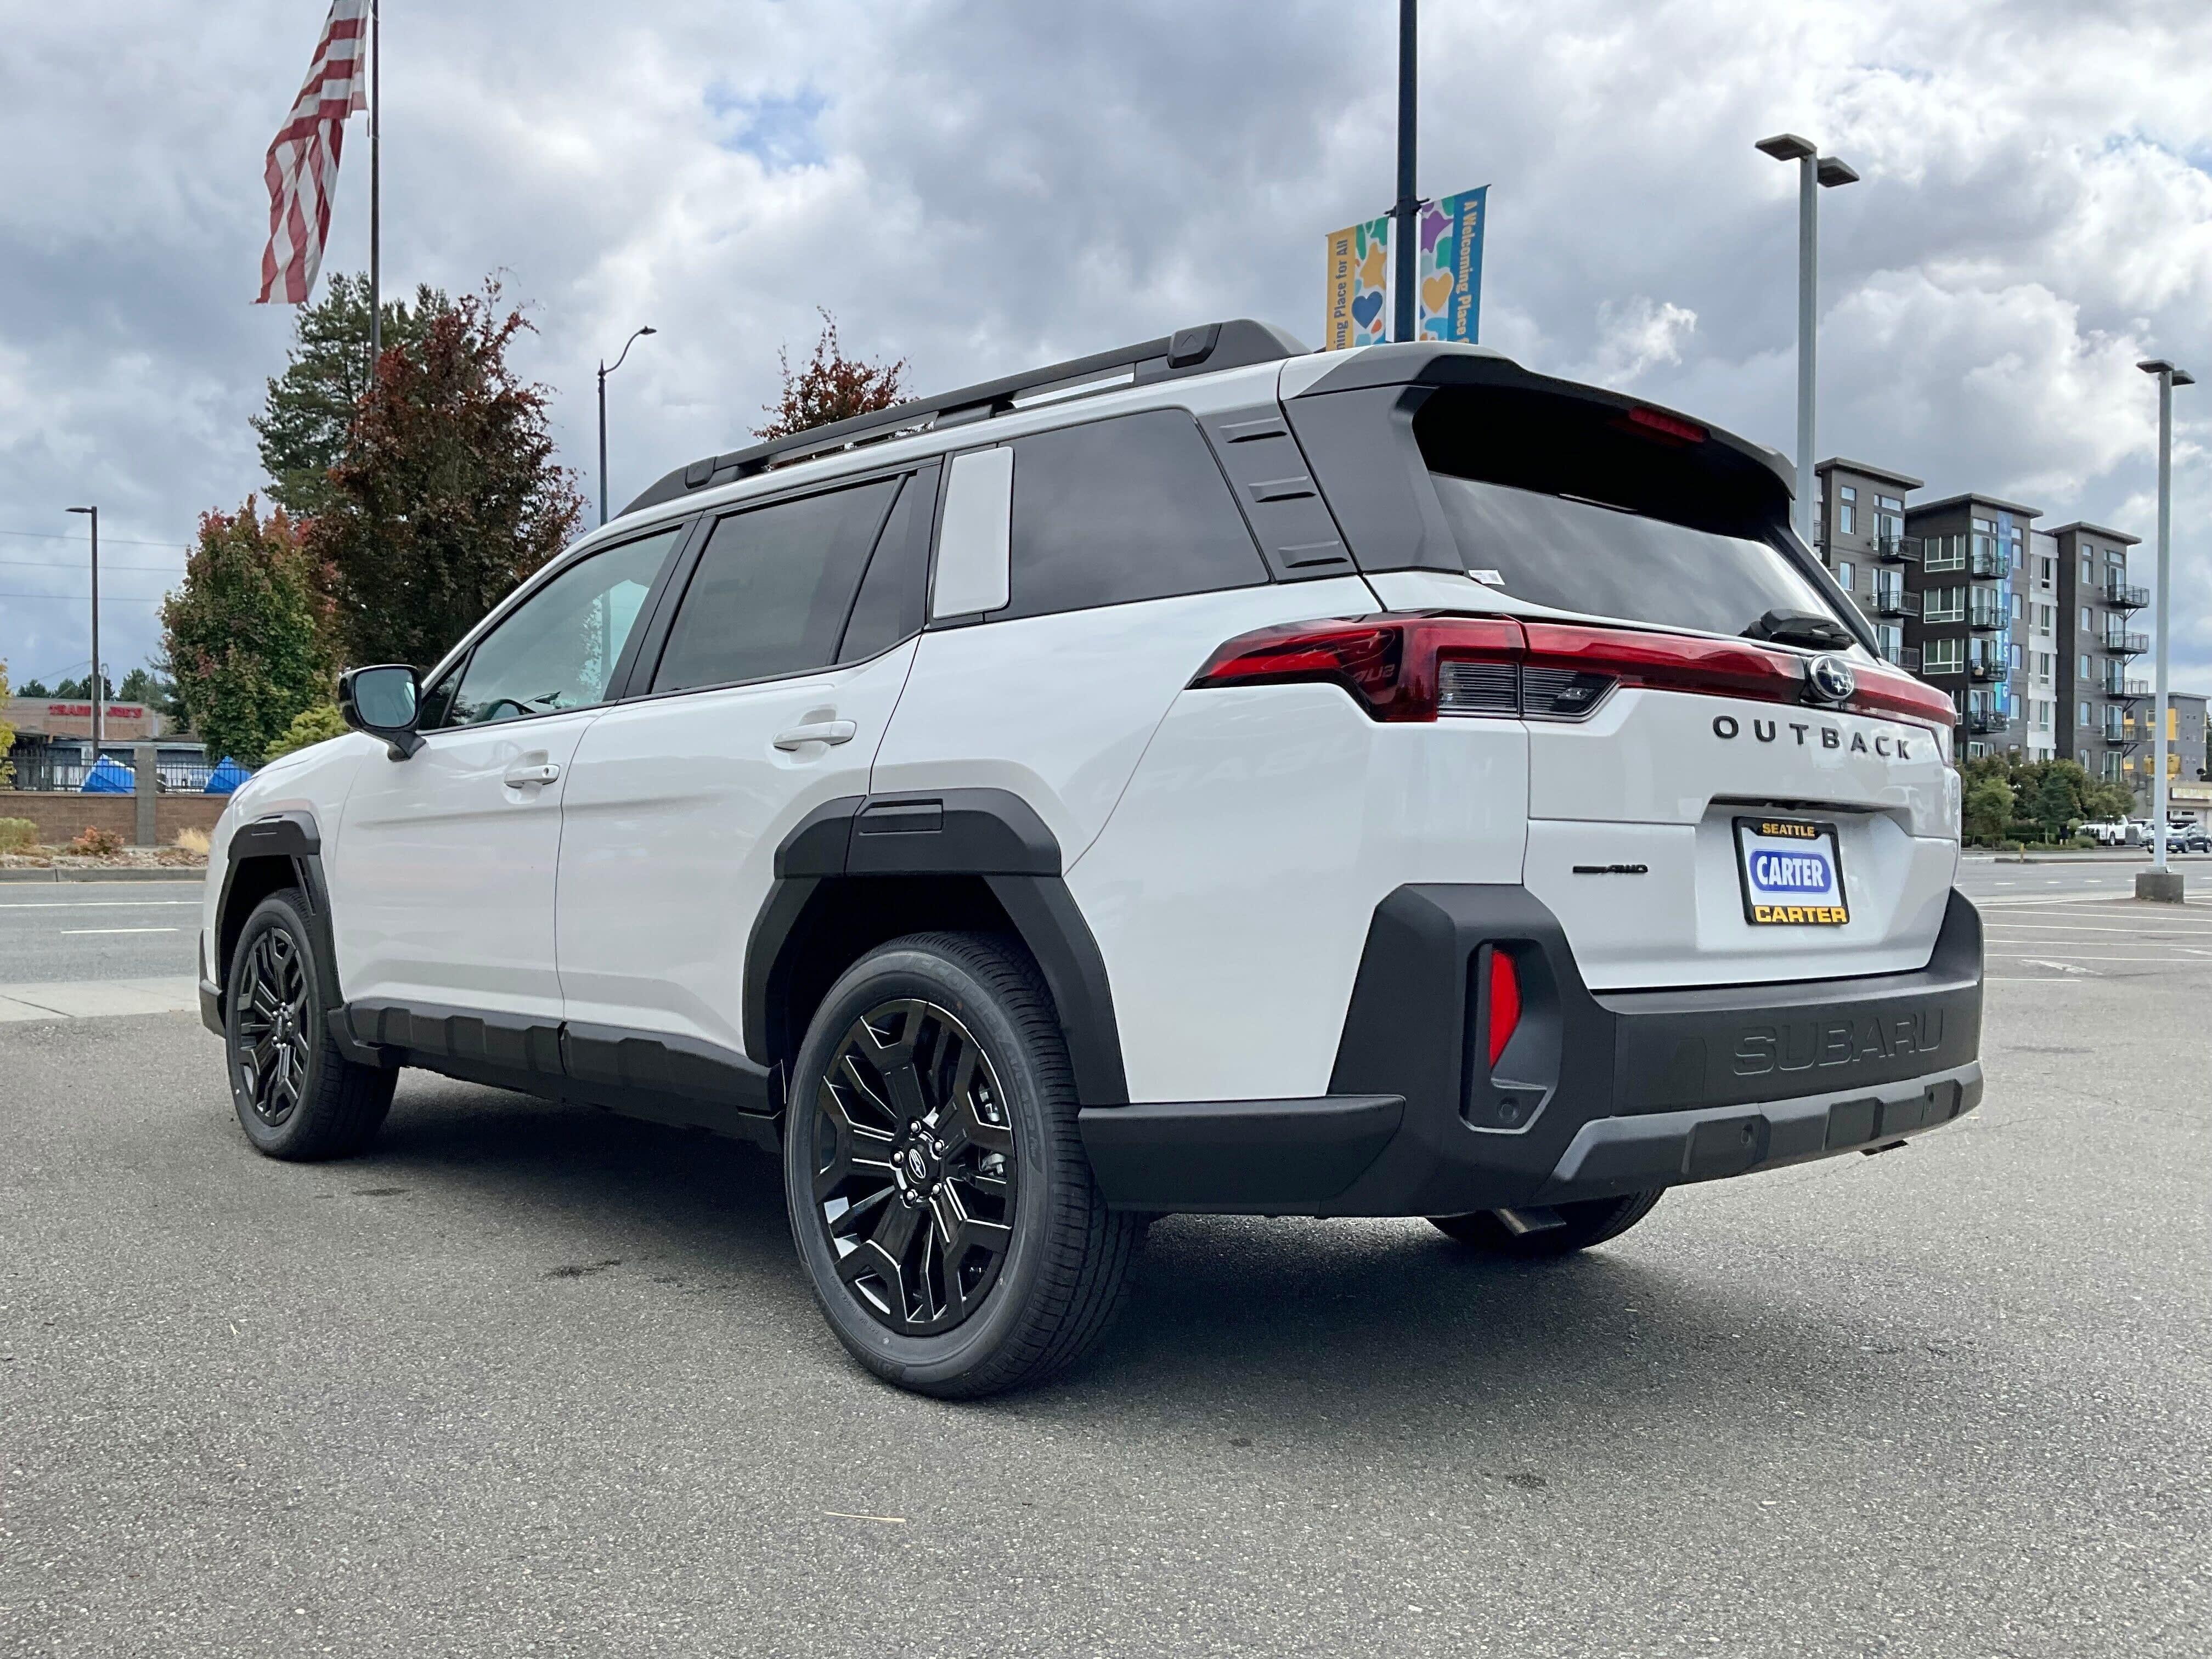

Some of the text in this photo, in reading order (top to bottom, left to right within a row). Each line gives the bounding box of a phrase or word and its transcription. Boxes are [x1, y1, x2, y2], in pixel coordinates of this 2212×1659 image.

[1464, 201, 1477, 211] A
[1336, 239, 1348, 256] All
[1456, 212, 1477, 294] Welcoming
[1335, 260, 1347, 280] for
[1334, 282, 1347, 318] Place
[1457, 295, 1471, 336] Place
[1713, 715, 1911, 759] OUTBACK
[1762, 822, 1815, 837] SEATTLE
[1757, 855, 1824, 887] CARTER
[1754, 906, 1848, 923] CARTER
[1733, 1008, 1944, 1075] SUBARU
